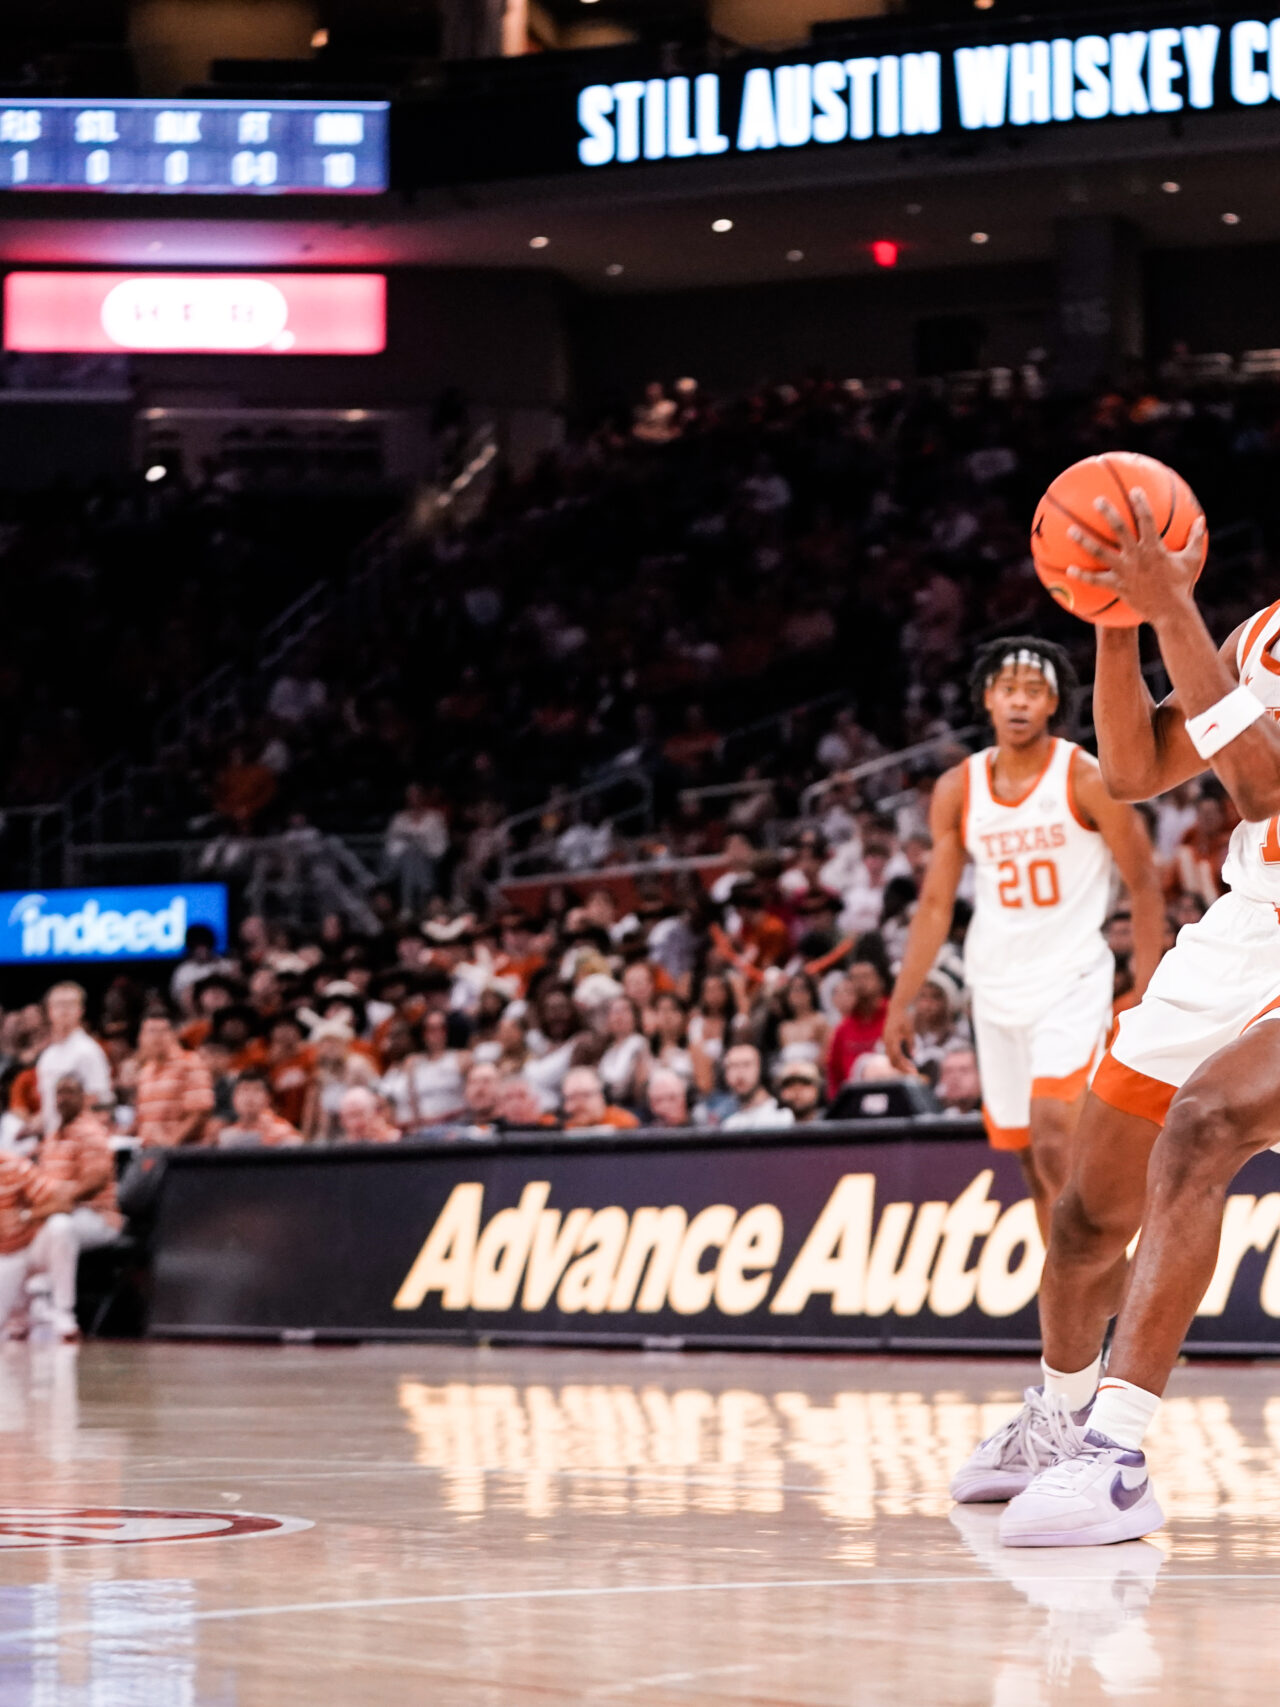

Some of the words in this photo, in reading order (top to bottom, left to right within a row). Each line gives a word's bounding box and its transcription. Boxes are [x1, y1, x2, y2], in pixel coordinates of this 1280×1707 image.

[578, 73, 729, 166] STILL
[737, 51, 942, 151] AUSTIN
[954, 24, 1220, 130] WHISKEY
[979, 823, 1067, 858] TEXAS
[998, 859, 1061, 909] 20
[21, 894, 188, 957] indeed
[393, 1180, 784, 1316] Advance
[770, 1172, 1045, 1317] Auto
